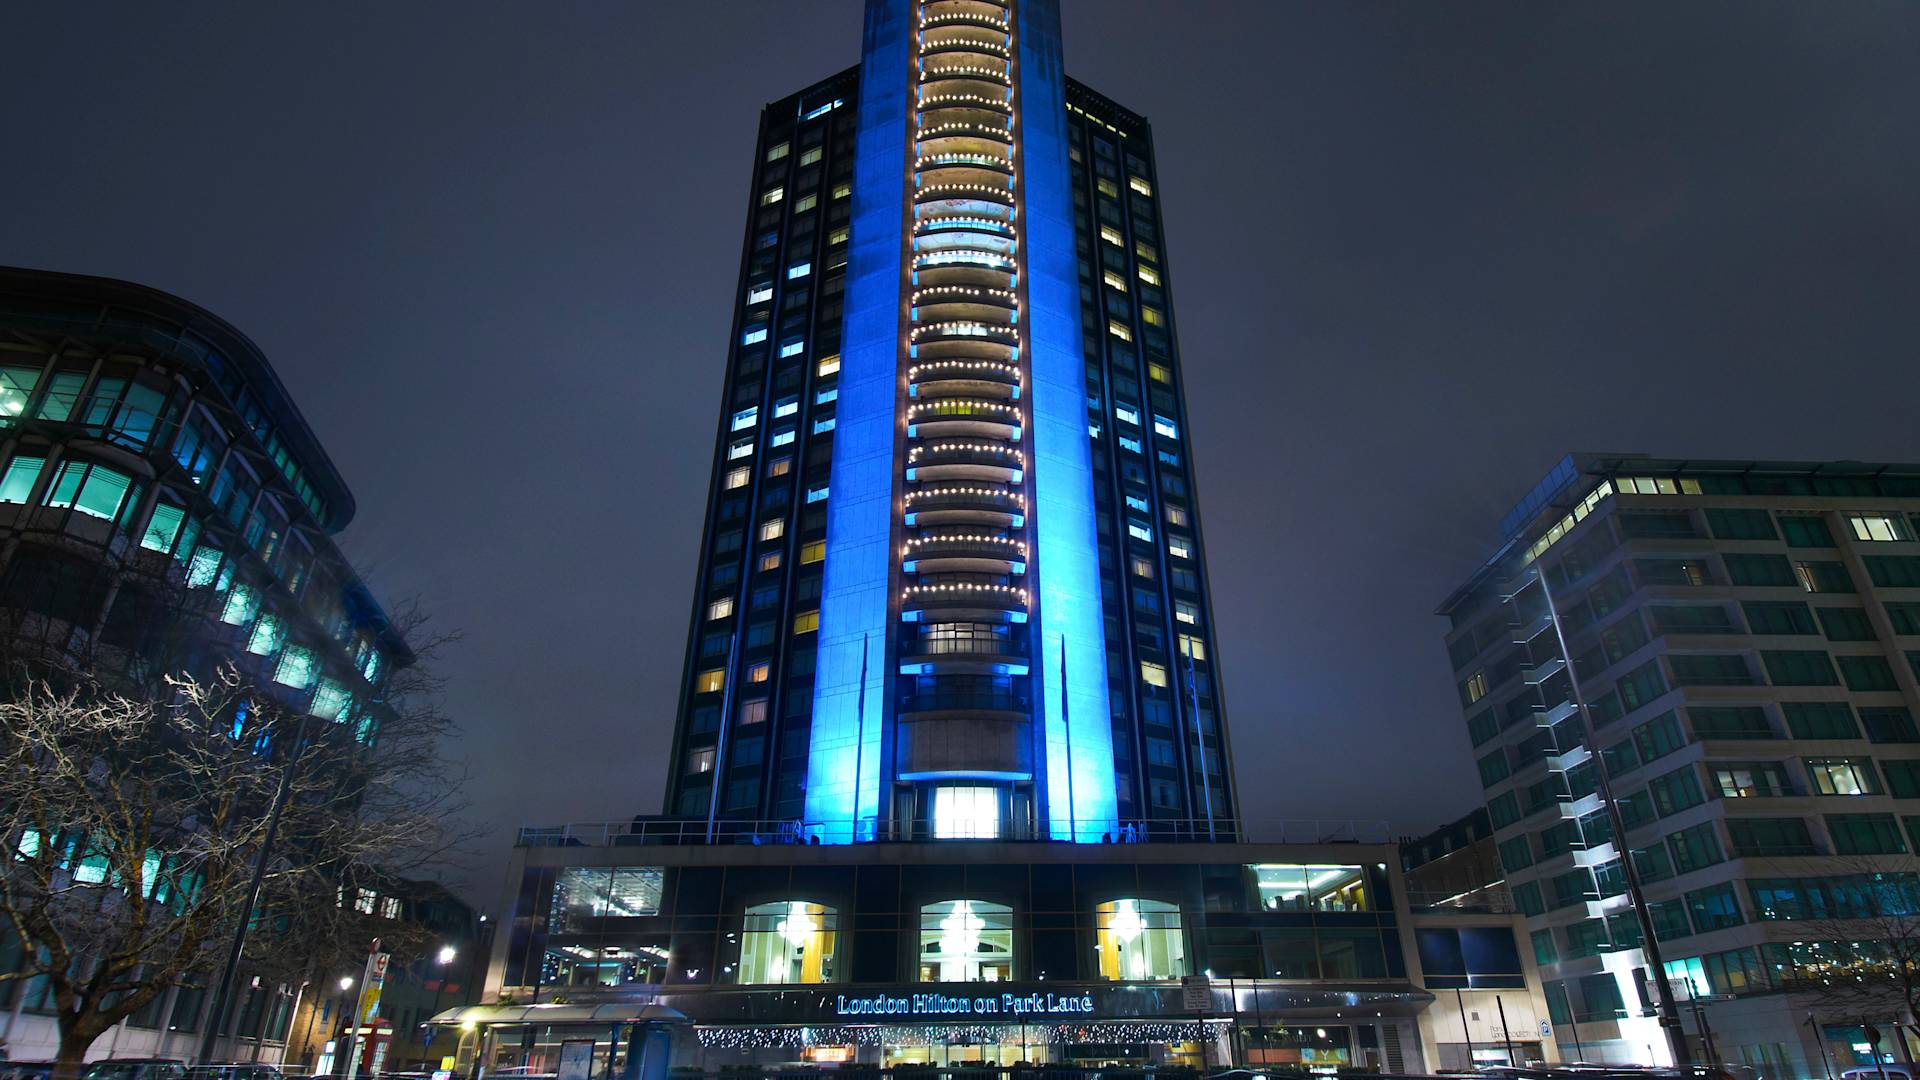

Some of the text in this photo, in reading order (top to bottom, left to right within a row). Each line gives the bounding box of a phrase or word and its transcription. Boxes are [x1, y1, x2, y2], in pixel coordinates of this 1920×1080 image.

[838, 993, 1094, 1014] London Hilton on Park Lane
